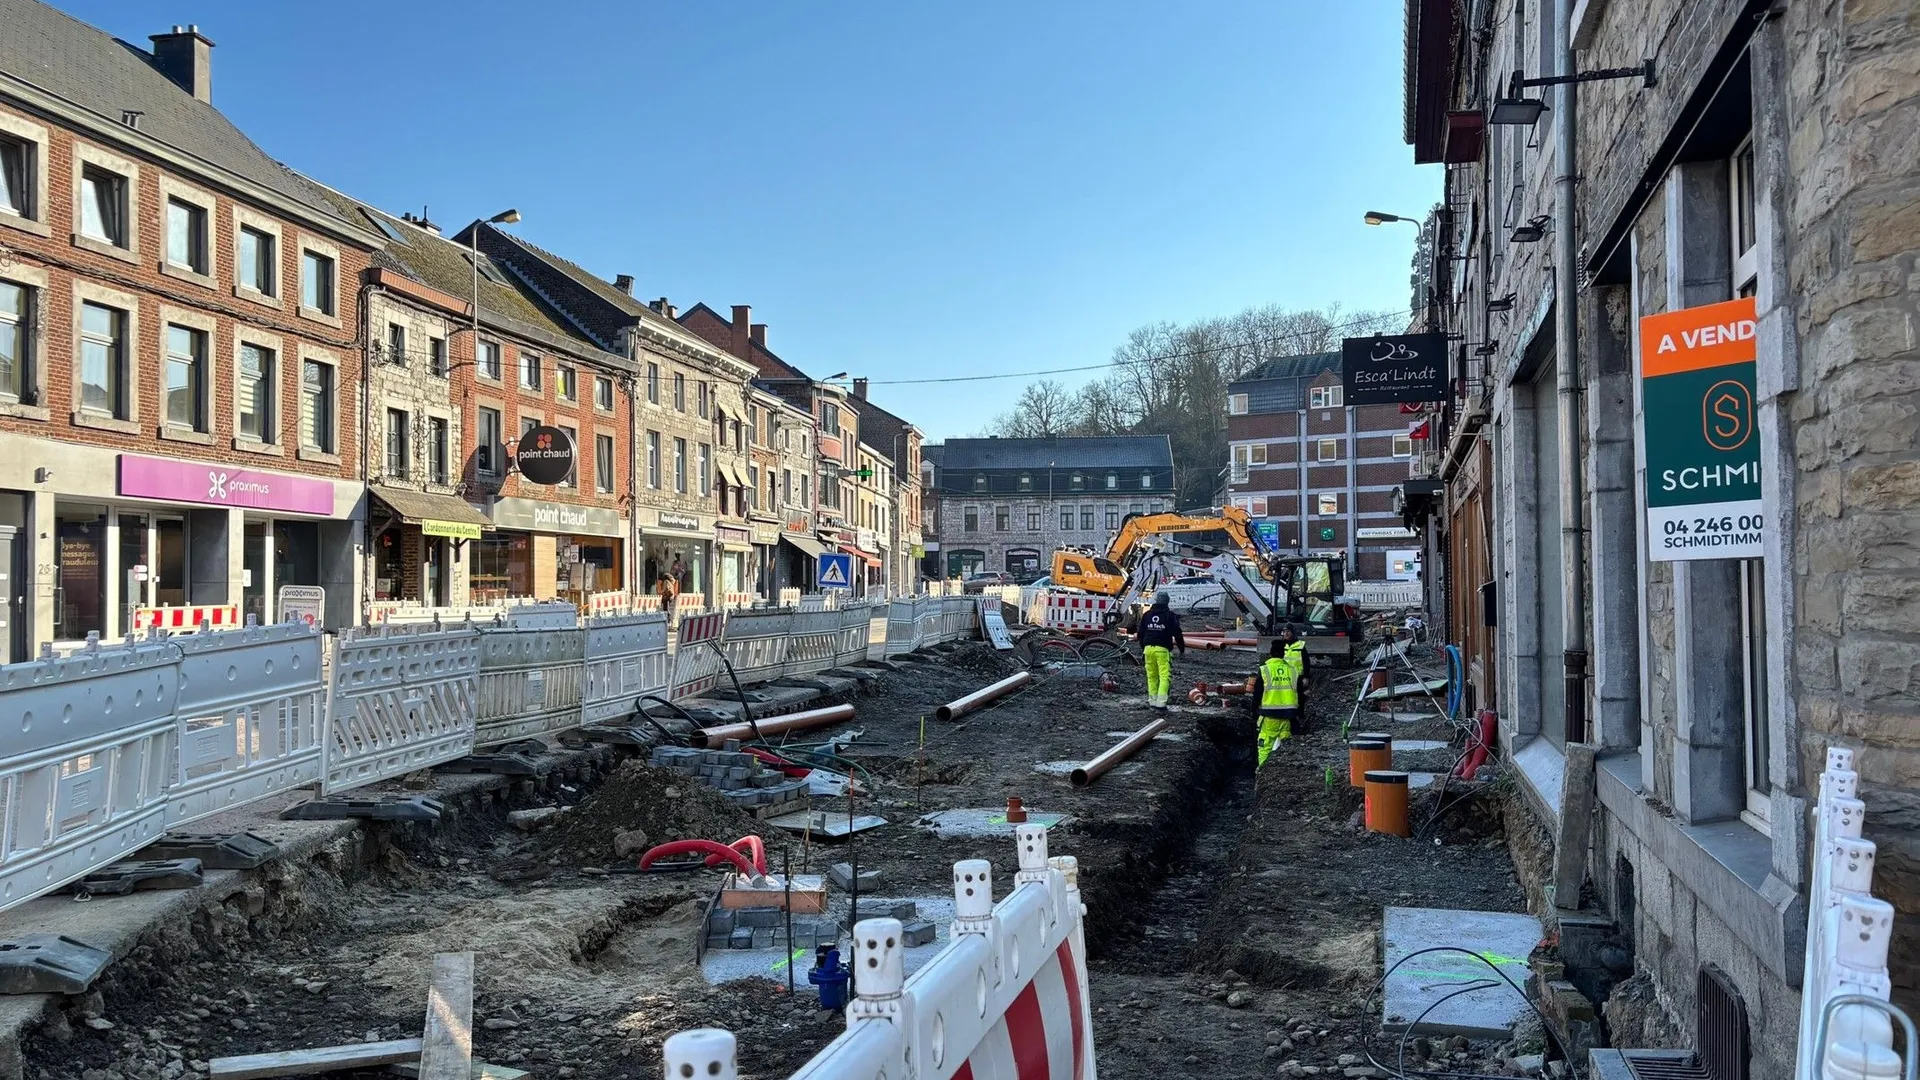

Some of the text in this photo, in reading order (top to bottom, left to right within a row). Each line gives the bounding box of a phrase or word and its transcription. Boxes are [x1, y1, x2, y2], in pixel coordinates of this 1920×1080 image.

[1657, 320, 1756, 354] A VEND
[520, 448, 570, 461] point chaud
[230, 480, 270, 494] proximus
[1662, 461, 1758, 491] SCHMI
[534, 504, 587, 527] point chaud
[1664, 514, 1764, 536] 04 246 00
[1664, 532, 1762, 548] SCHMIDTIMM
